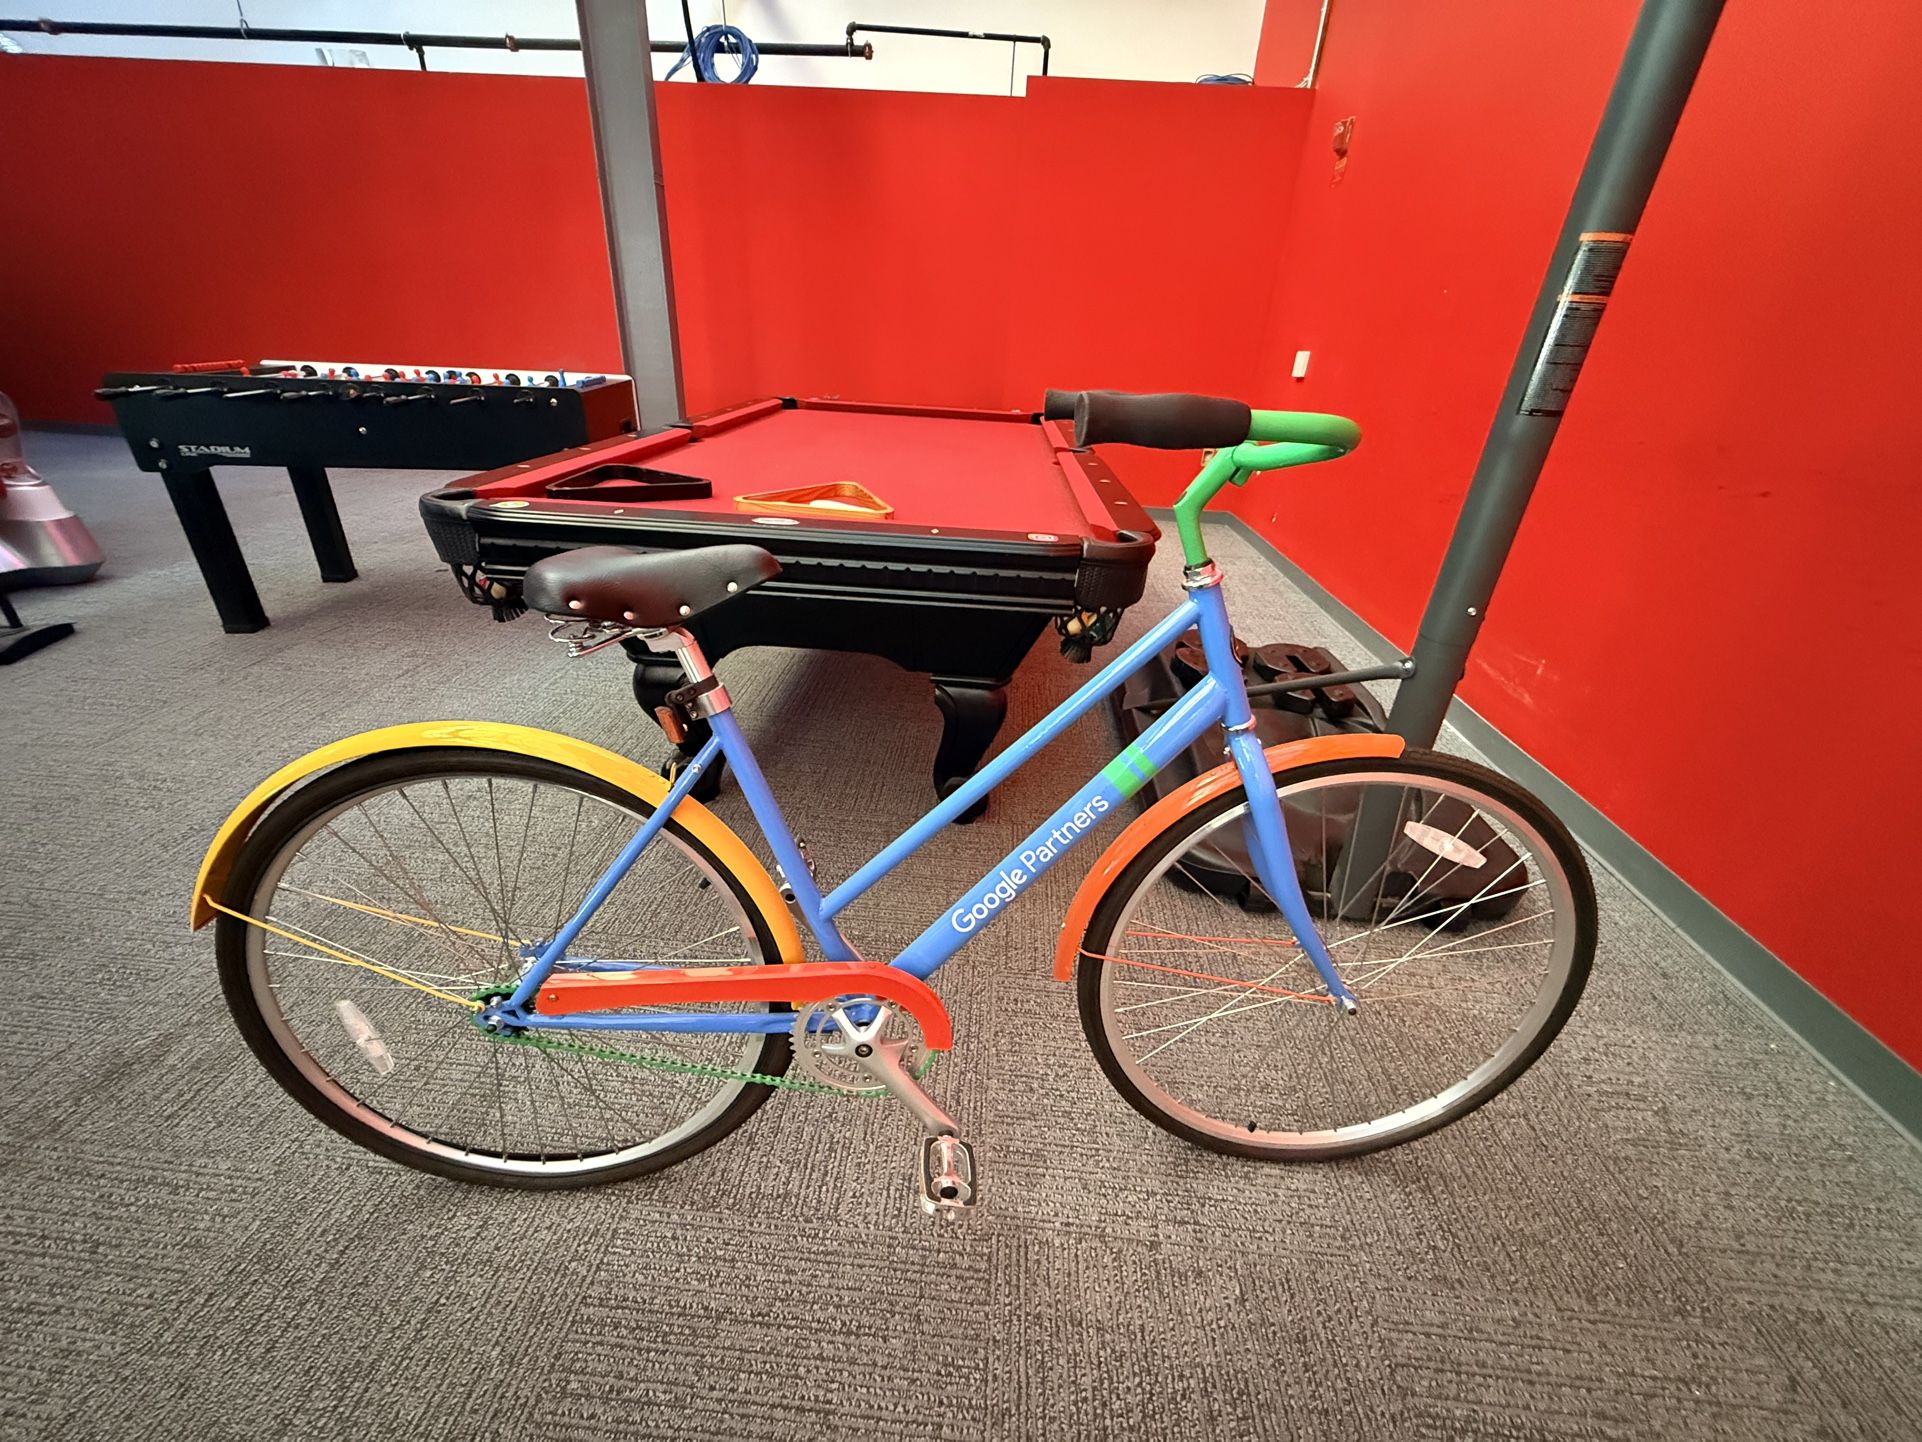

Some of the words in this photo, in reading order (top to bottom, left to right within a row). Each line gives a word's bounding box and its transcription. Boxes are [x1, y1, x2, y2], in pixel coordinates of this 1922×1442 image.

[178, 445, 251, 454] STADIUM
[951, 868, 1028, 933] Google
[1019, 795, 1109, 873] Partners
